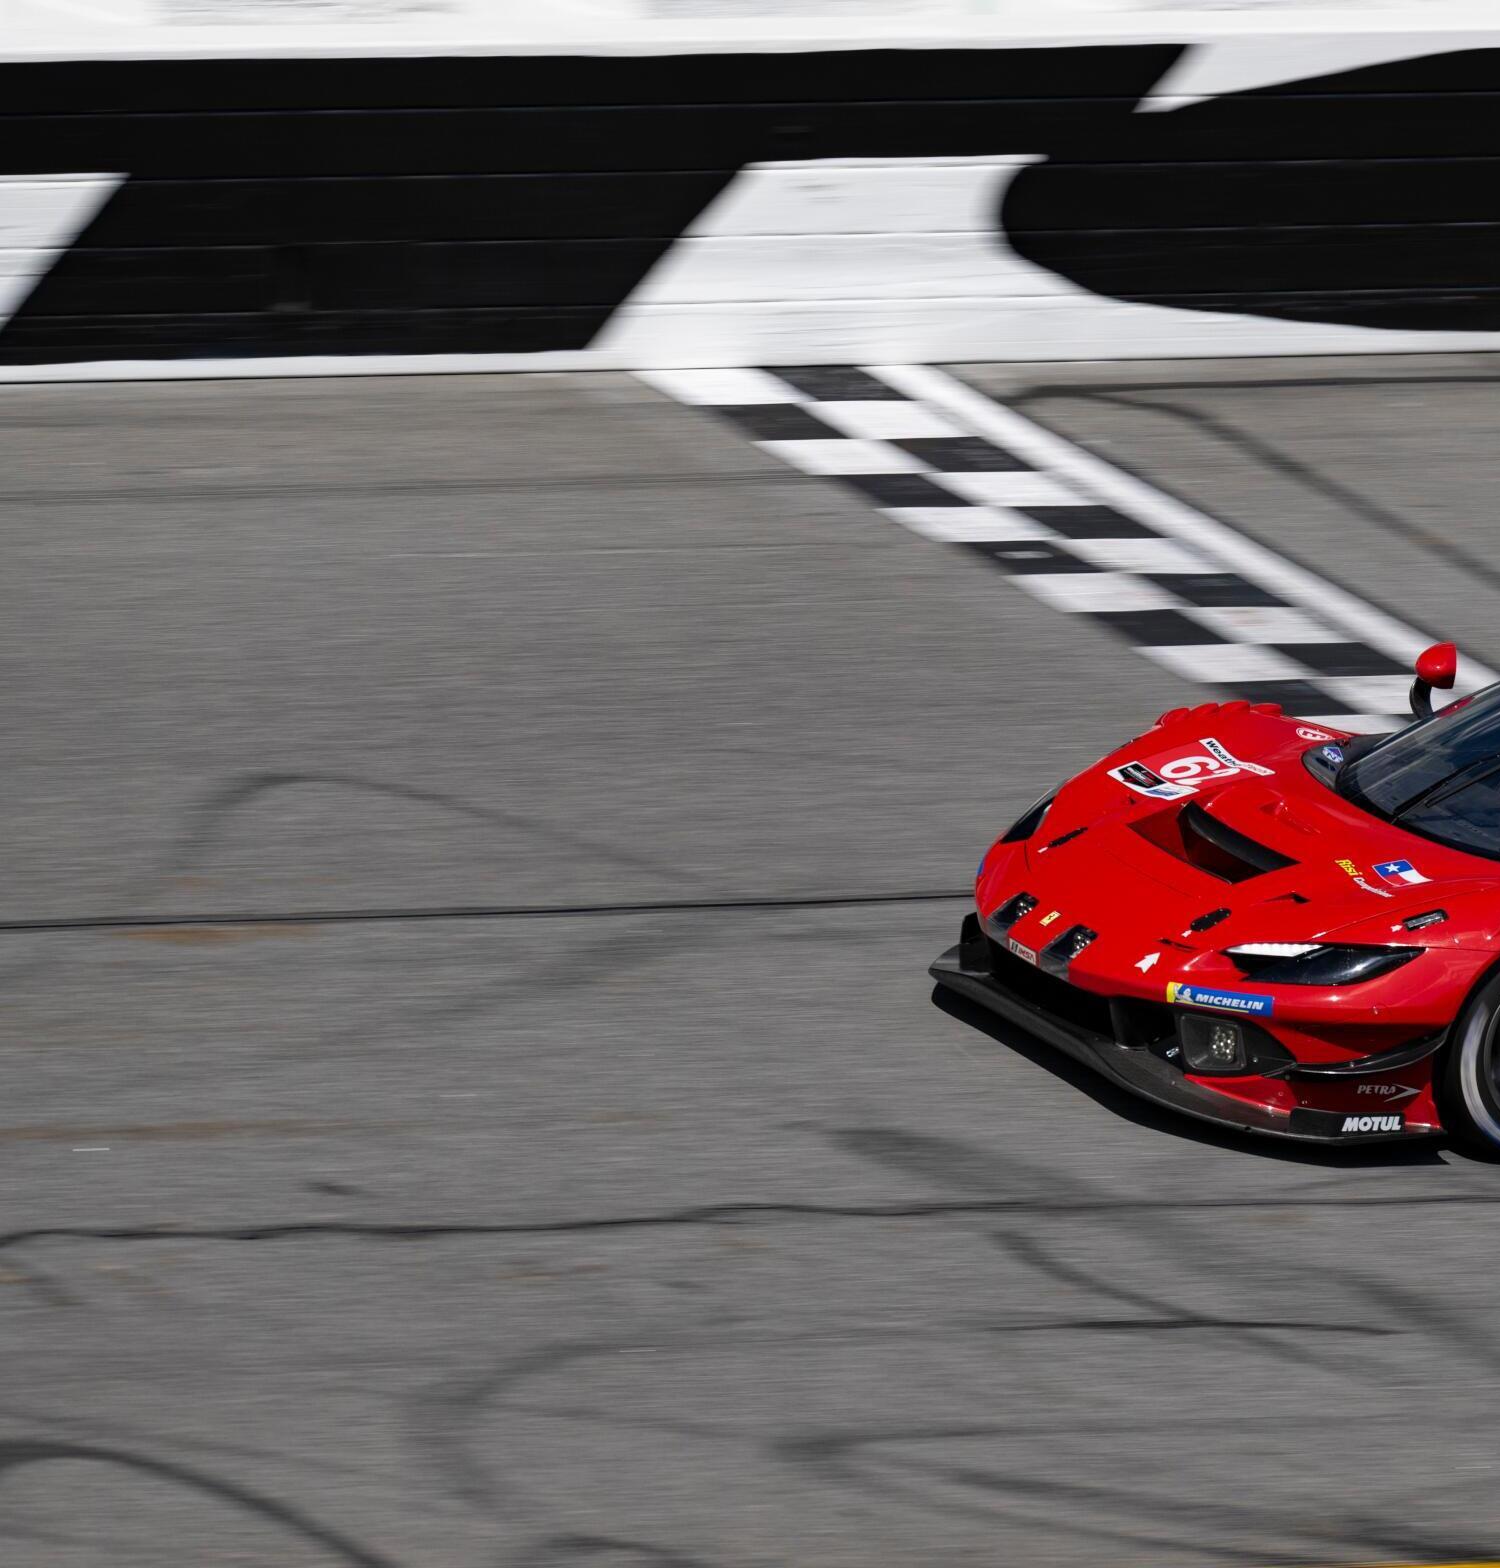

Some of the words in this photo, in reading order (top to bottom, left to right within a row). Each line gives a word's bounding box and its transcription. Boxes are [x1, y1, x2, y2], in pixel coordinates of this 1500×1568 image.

[1334, 859, 1363, 876] Risi
[1195, 993, 1264, 1010] MICHELIN
[1357, 1084, 1397, 1095] PETRA
[1341, 1116, 1402, 1132] MOTUL
